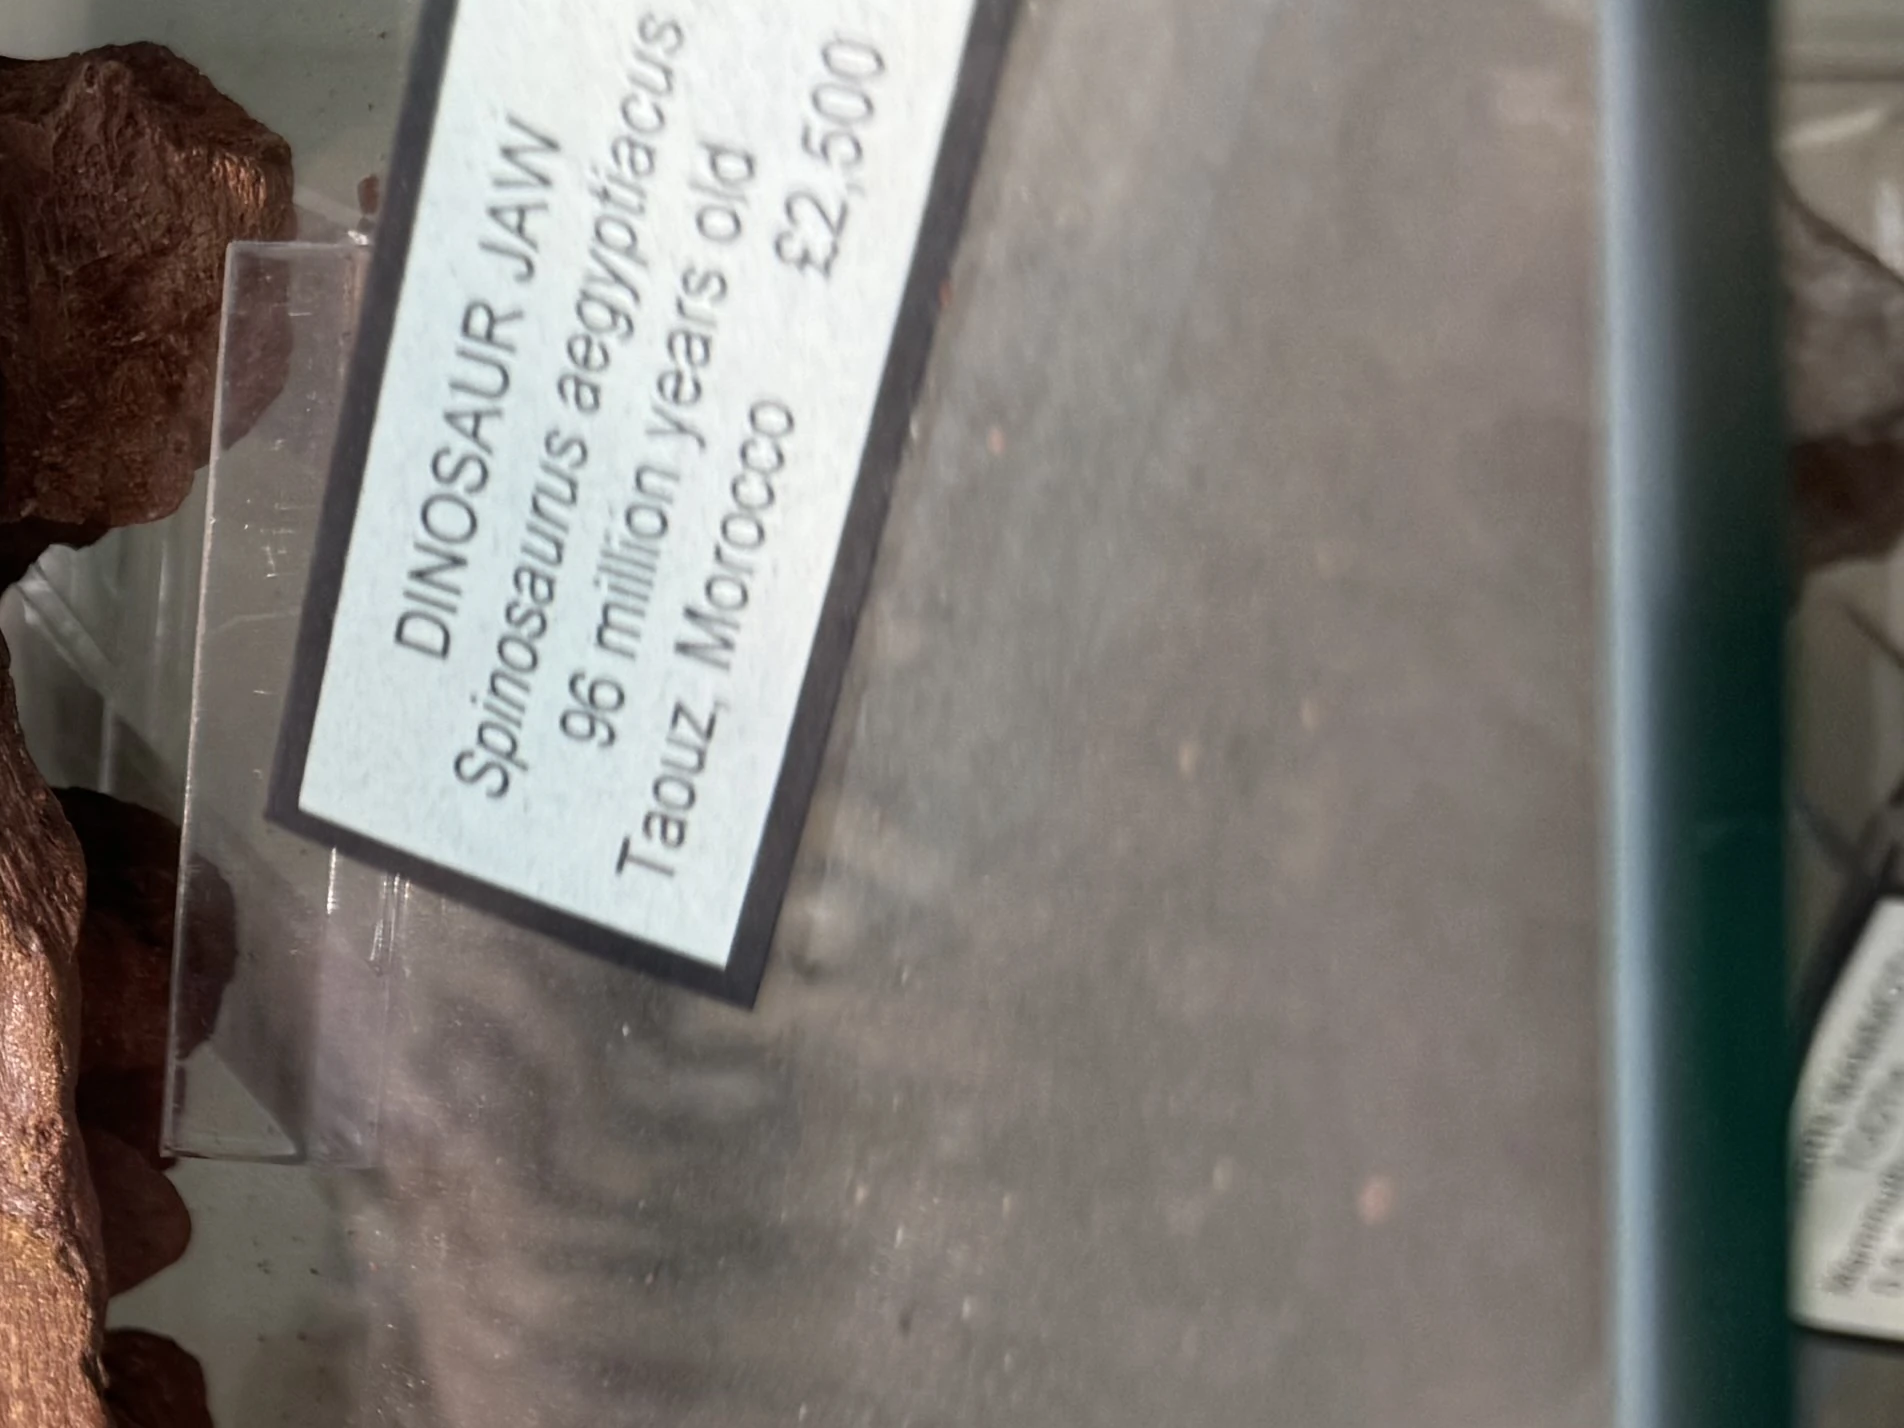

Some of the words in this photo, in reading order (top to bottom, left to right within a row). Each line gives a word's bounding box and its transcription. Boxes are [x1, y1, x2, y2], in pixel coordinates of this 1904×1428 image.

[683, 138, 756, 244] old
[767, 33, 888, 279] £2,500
[392, 297, 521, 661] DINOSAUR
[472, 112, 563, 283] JAW
[453, 426, 591, 800] Spinosaurus
[551, 12, 686, 416] aegyptiacus
[640, 268, 730, 442] years
[584, 460, 677, 663] million
[672, 397, 795, 673] Morocco
[558, 671, 627, 750] 96
[616, 694, 732, 884] Taouz,
